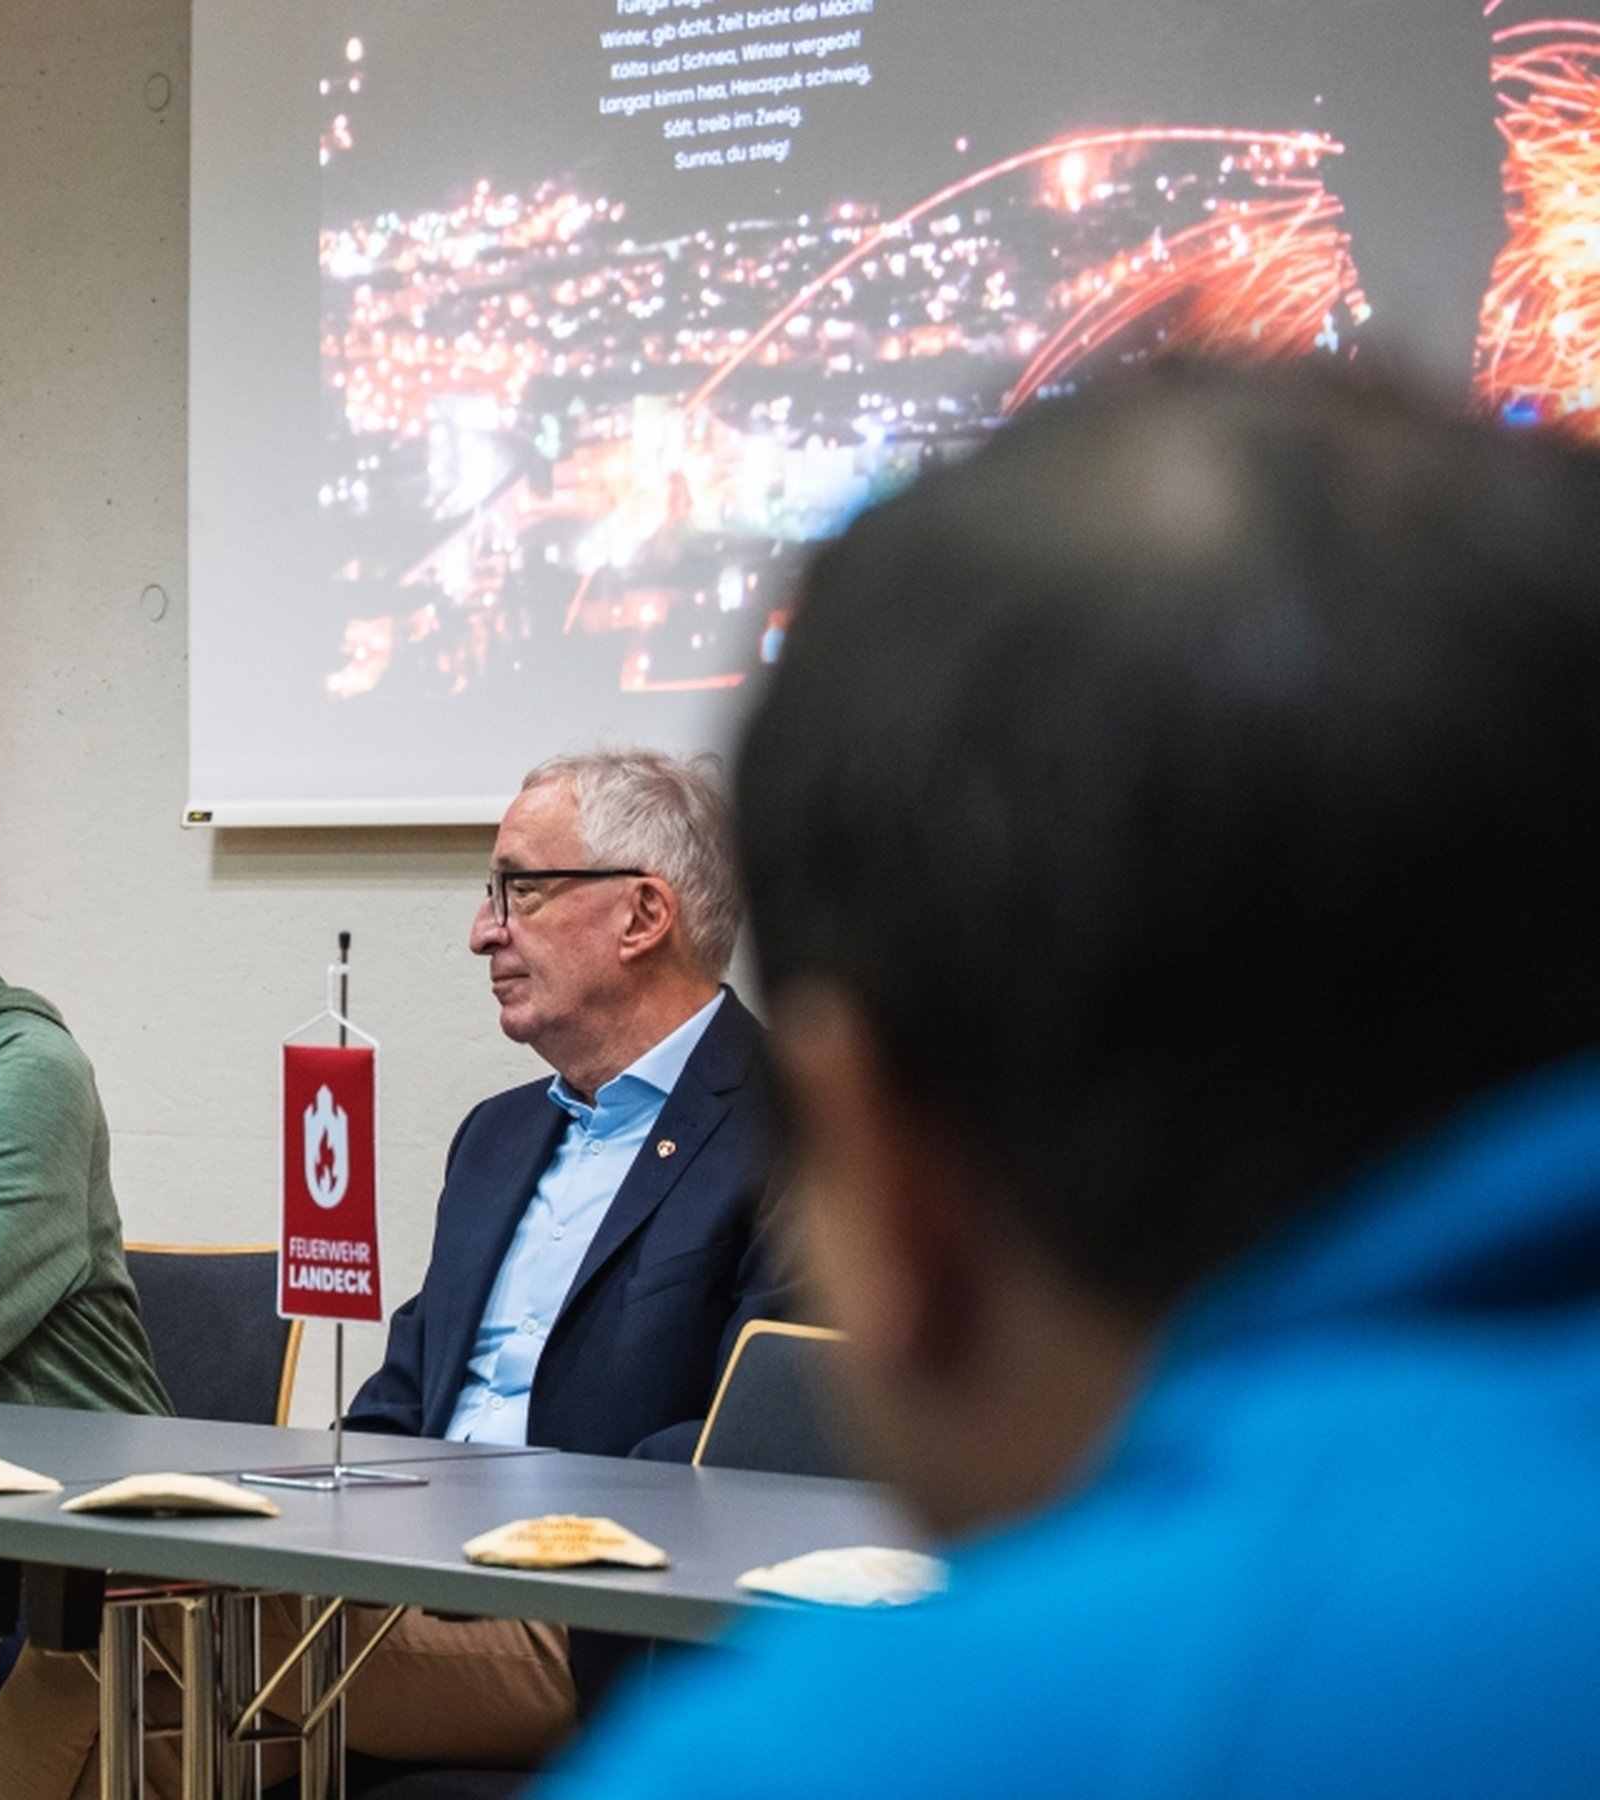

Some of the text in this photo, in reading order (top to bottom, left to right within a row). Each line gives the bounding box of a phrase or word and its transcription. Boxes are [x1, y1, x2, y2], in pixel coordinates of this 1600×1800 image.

[652, 23, 676, 48] gib
[717, 12, 744, 33] Zeit
[746, 7, 791, 28] bricht
[792, 1, 818, 22] die
[651, 54, 680, 75] und
[741, 41, 790, 62] Winter
[730, 71, 803, 96] Hexaspuk
[697, 112, 732, 134] treib
[733, 111, 754, 128] im
[726, 144, 747, 163] du
[749, 138, 791, 163] steig!
[289, 1236, 371, 1265] FEUERWEHR
[289, 1264, 373, 1296] LANDECK
